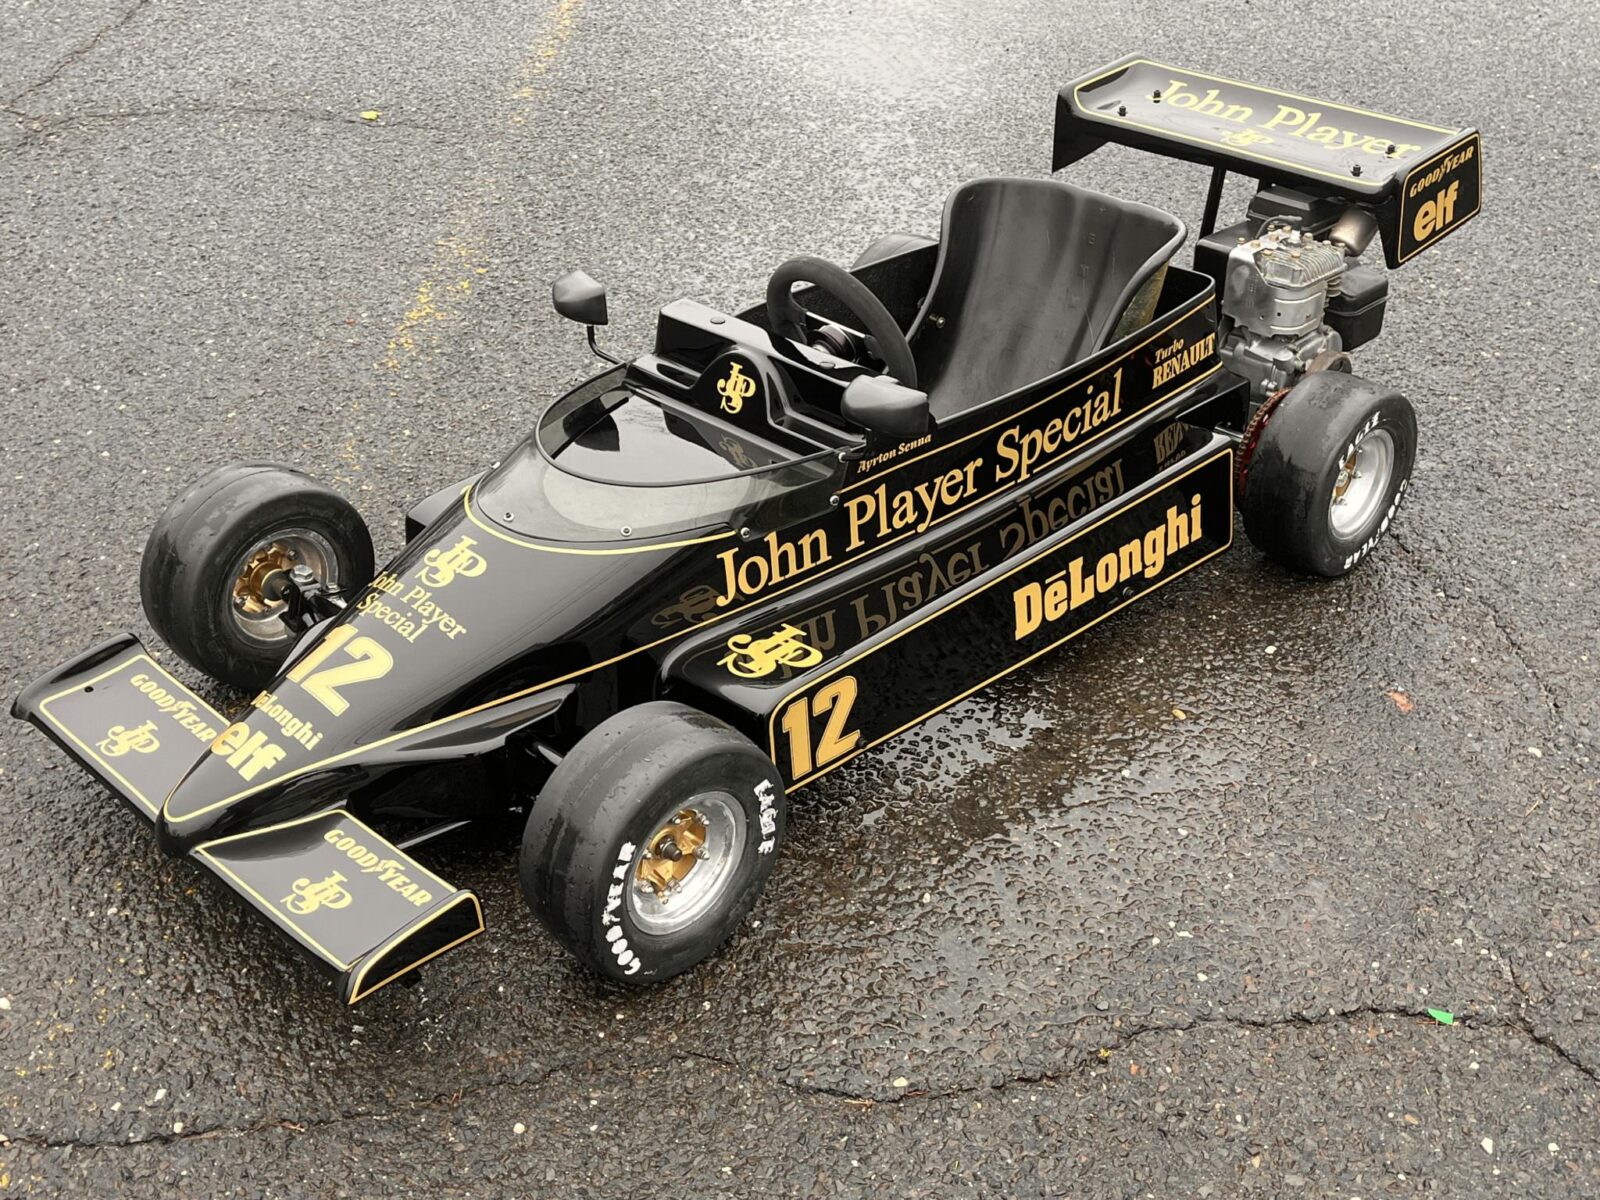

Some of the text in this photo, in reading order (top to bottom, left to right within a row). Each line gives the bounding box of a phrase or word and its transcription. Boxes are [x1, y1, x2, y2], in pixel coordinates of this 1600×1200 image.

[1146, 79, 1421, 159] John Player
[1413, 180, 1459, 241] elf
[1151, 332, 1216, 389] RENAULT
[1154, 338, 1184, 364] Turbo
[857, 433, 932, 474] Ayrton Senna
[716, 528, 832, 606] John
[843, 458, 984, 554] Player
[995, 368, 1124, 484] Special
[356, 592, 430, 644] Special
[400, 585, 468, 640] Player
[286, 623, 394, 718] 12
[210, 721, 288, 783] elf
[781, 675, 861, 780] 12
